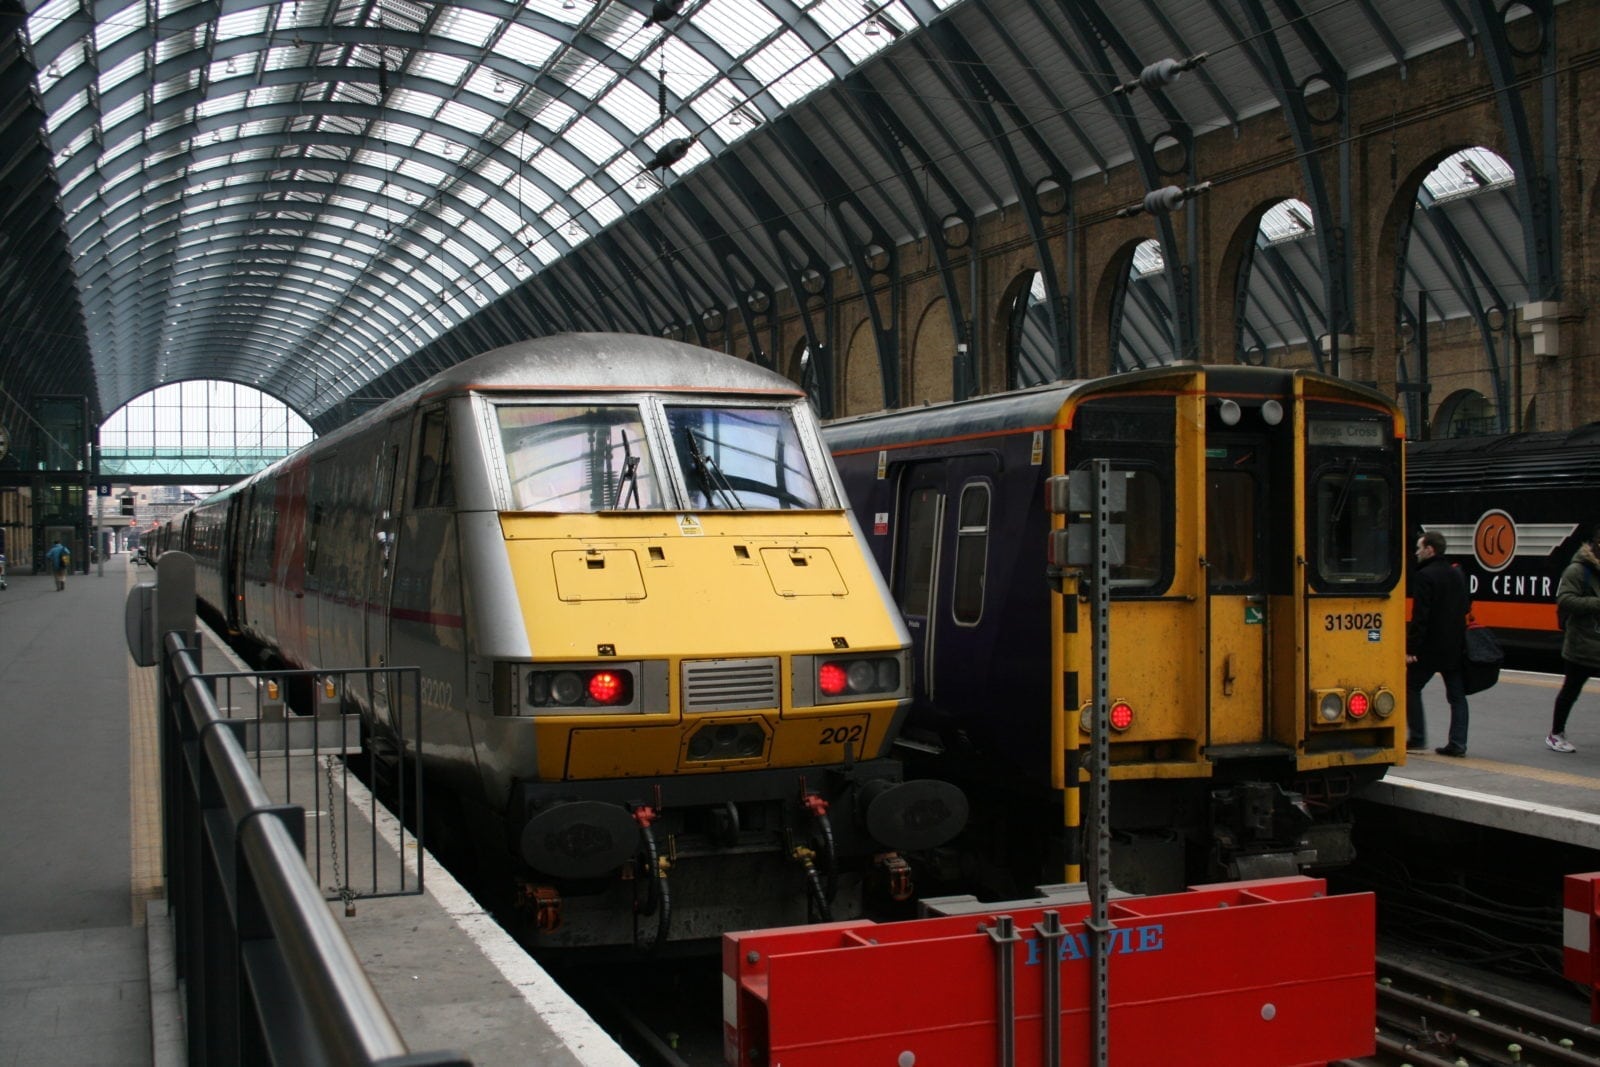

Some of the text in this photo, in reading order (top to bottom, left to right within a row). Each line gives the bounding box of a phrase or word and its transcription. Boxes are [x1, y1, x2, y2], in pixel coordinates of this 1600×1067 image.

[1346, 425, 1378, 437] Cross
[1492, 575, 1562, 597] CENTR
[1325, 613, 1382, 631] 313026
[819, 725, 862, 745] 202
